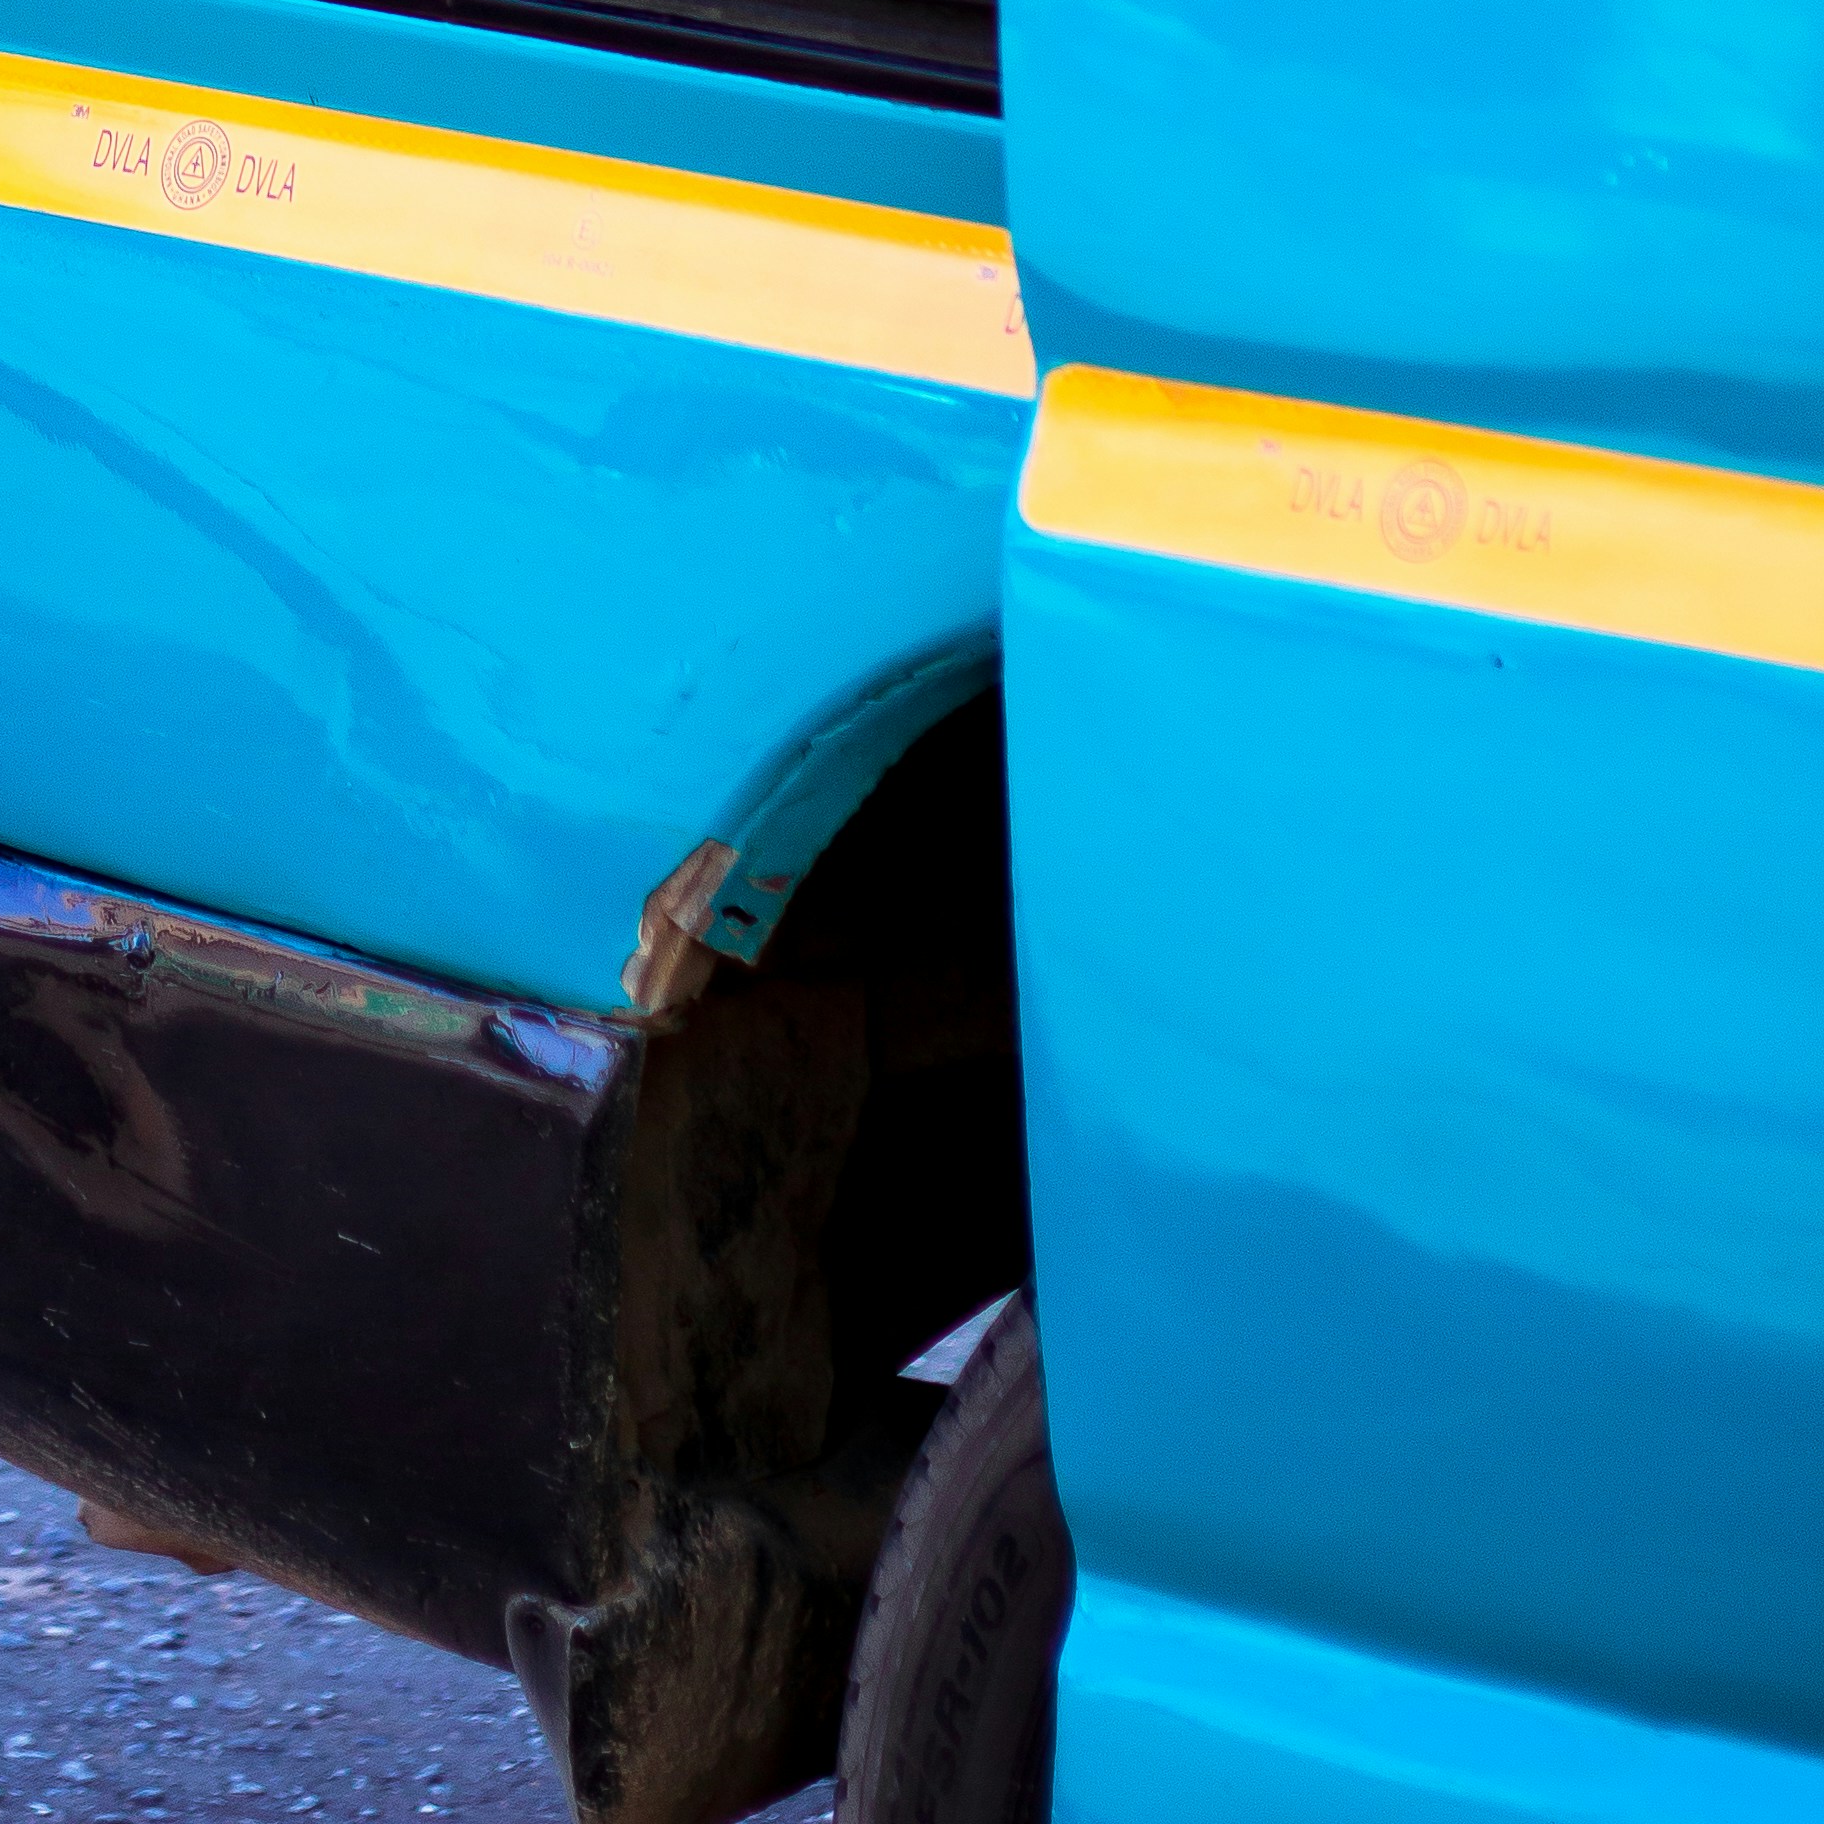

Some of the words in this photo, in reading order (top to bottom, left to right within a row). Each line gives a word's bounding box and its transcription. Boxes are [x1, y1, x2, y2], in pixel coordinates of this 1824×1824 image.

[93, 129, 150, 176] DVLA
[236, 154, 296, 202] DVLA
[1289, 465, 1365, 523] DVLA
[1476, 499, 1553, 554] DVLA
